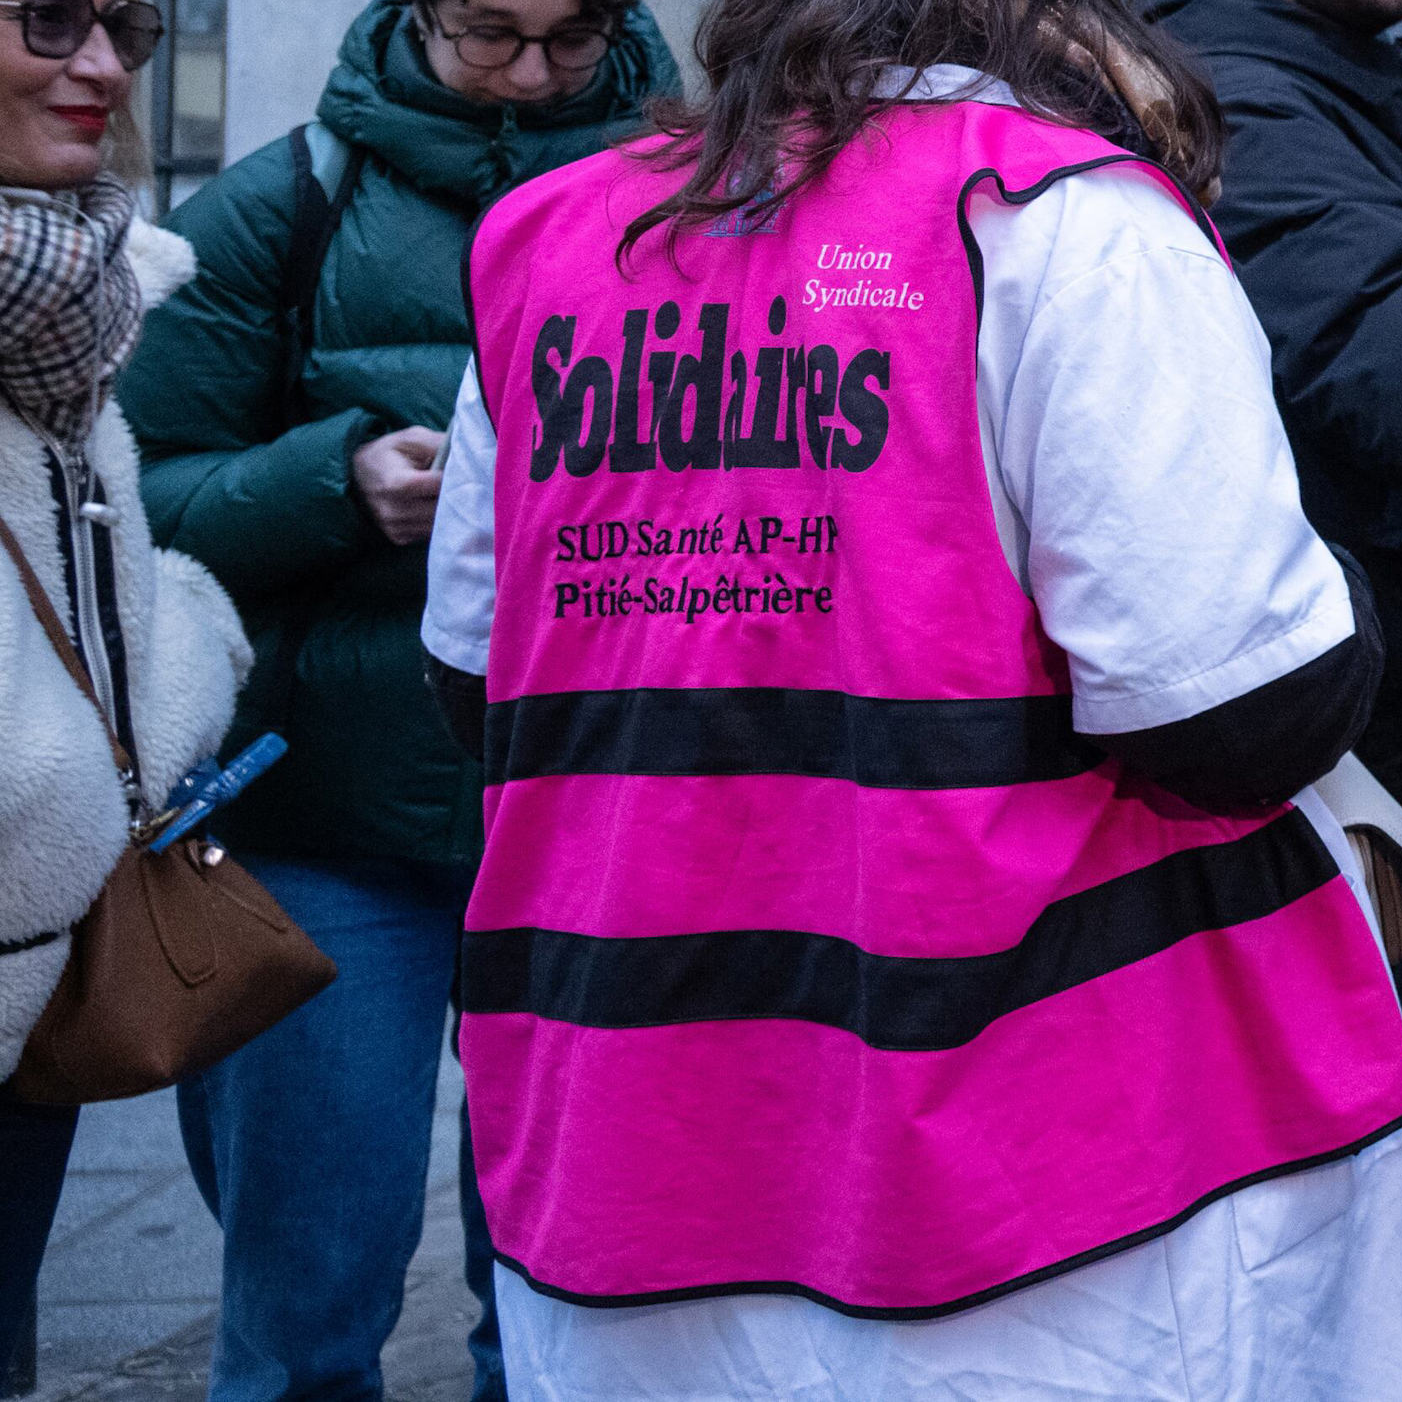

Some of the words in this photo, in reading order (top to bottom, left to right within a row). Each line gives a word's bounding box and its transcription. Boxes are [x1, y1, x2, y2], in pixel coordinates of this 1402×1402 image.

[816, 244, 893, 270] Union
[802, 279, 924, 312] Syndicale
[530, 295, 891, 483] Solidaires
[556, 522, 629, 561] SUD
[636, 513, 724, 556] Santé
[554, 572, 834, 624] Pitié-Salpêtrière
